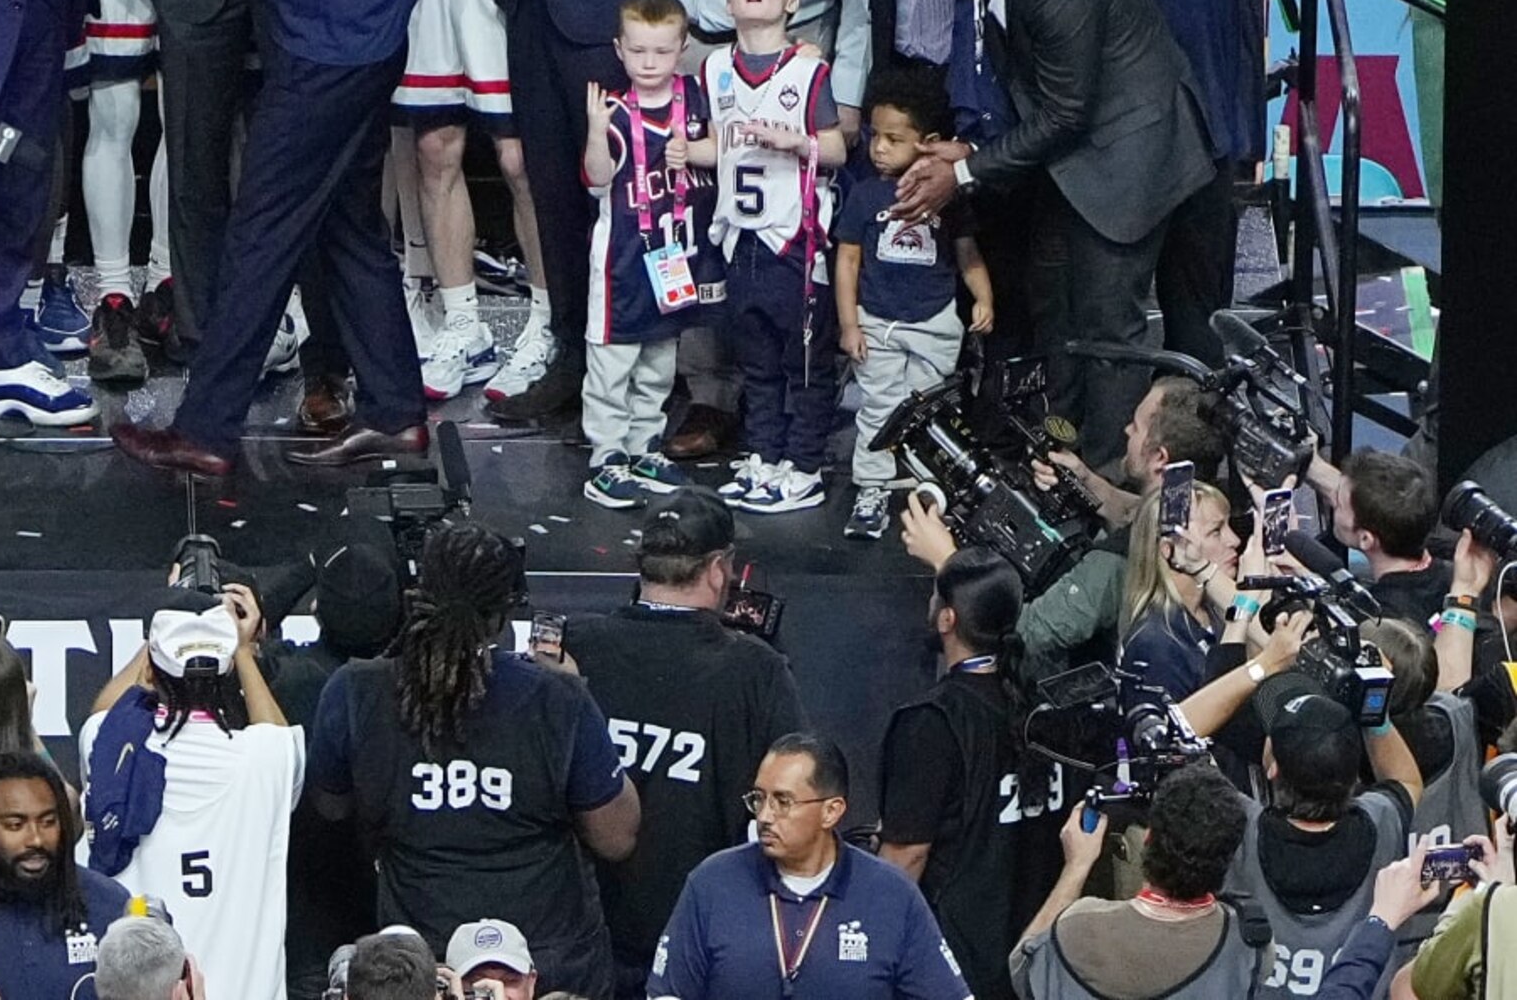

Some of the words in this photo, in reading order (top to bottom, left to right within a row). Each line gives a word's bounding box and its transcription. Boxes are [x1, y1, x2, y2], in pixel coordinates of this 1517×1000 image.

[734, 164, 766, 217] 5
[607, 717, 706, 783] 572
[411, 760, 513, 811] 389
[998, 761, 1064, 824] 29
[180, 850, 214, 898] 5
